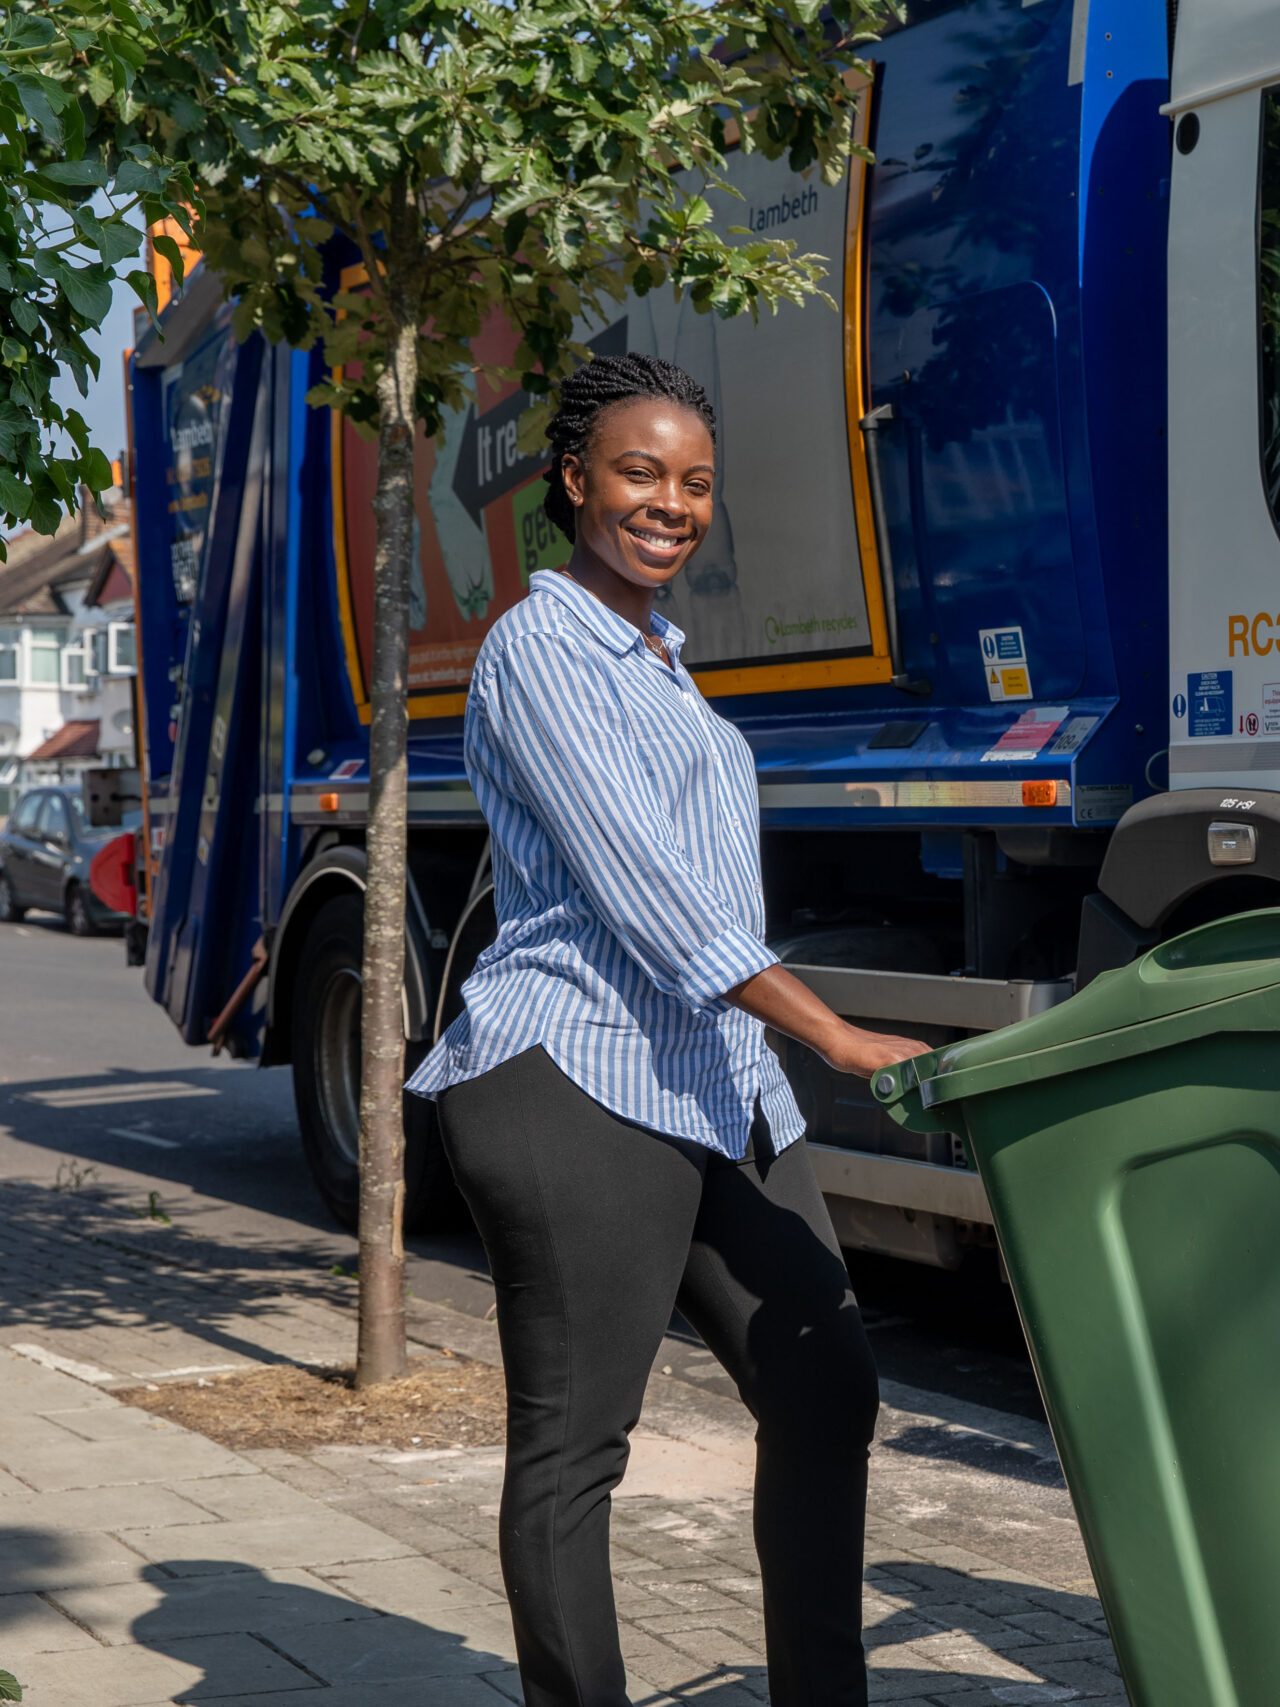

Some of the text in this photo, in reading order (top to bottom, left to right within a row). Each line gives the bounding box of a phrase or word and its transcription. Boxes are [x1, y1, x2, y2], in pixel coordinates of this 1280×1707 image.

[749, 184, 819, 233] Lambeth
[477, 425, 492, 486] It
[780, 612, 858, 636] Lambeth recycles
